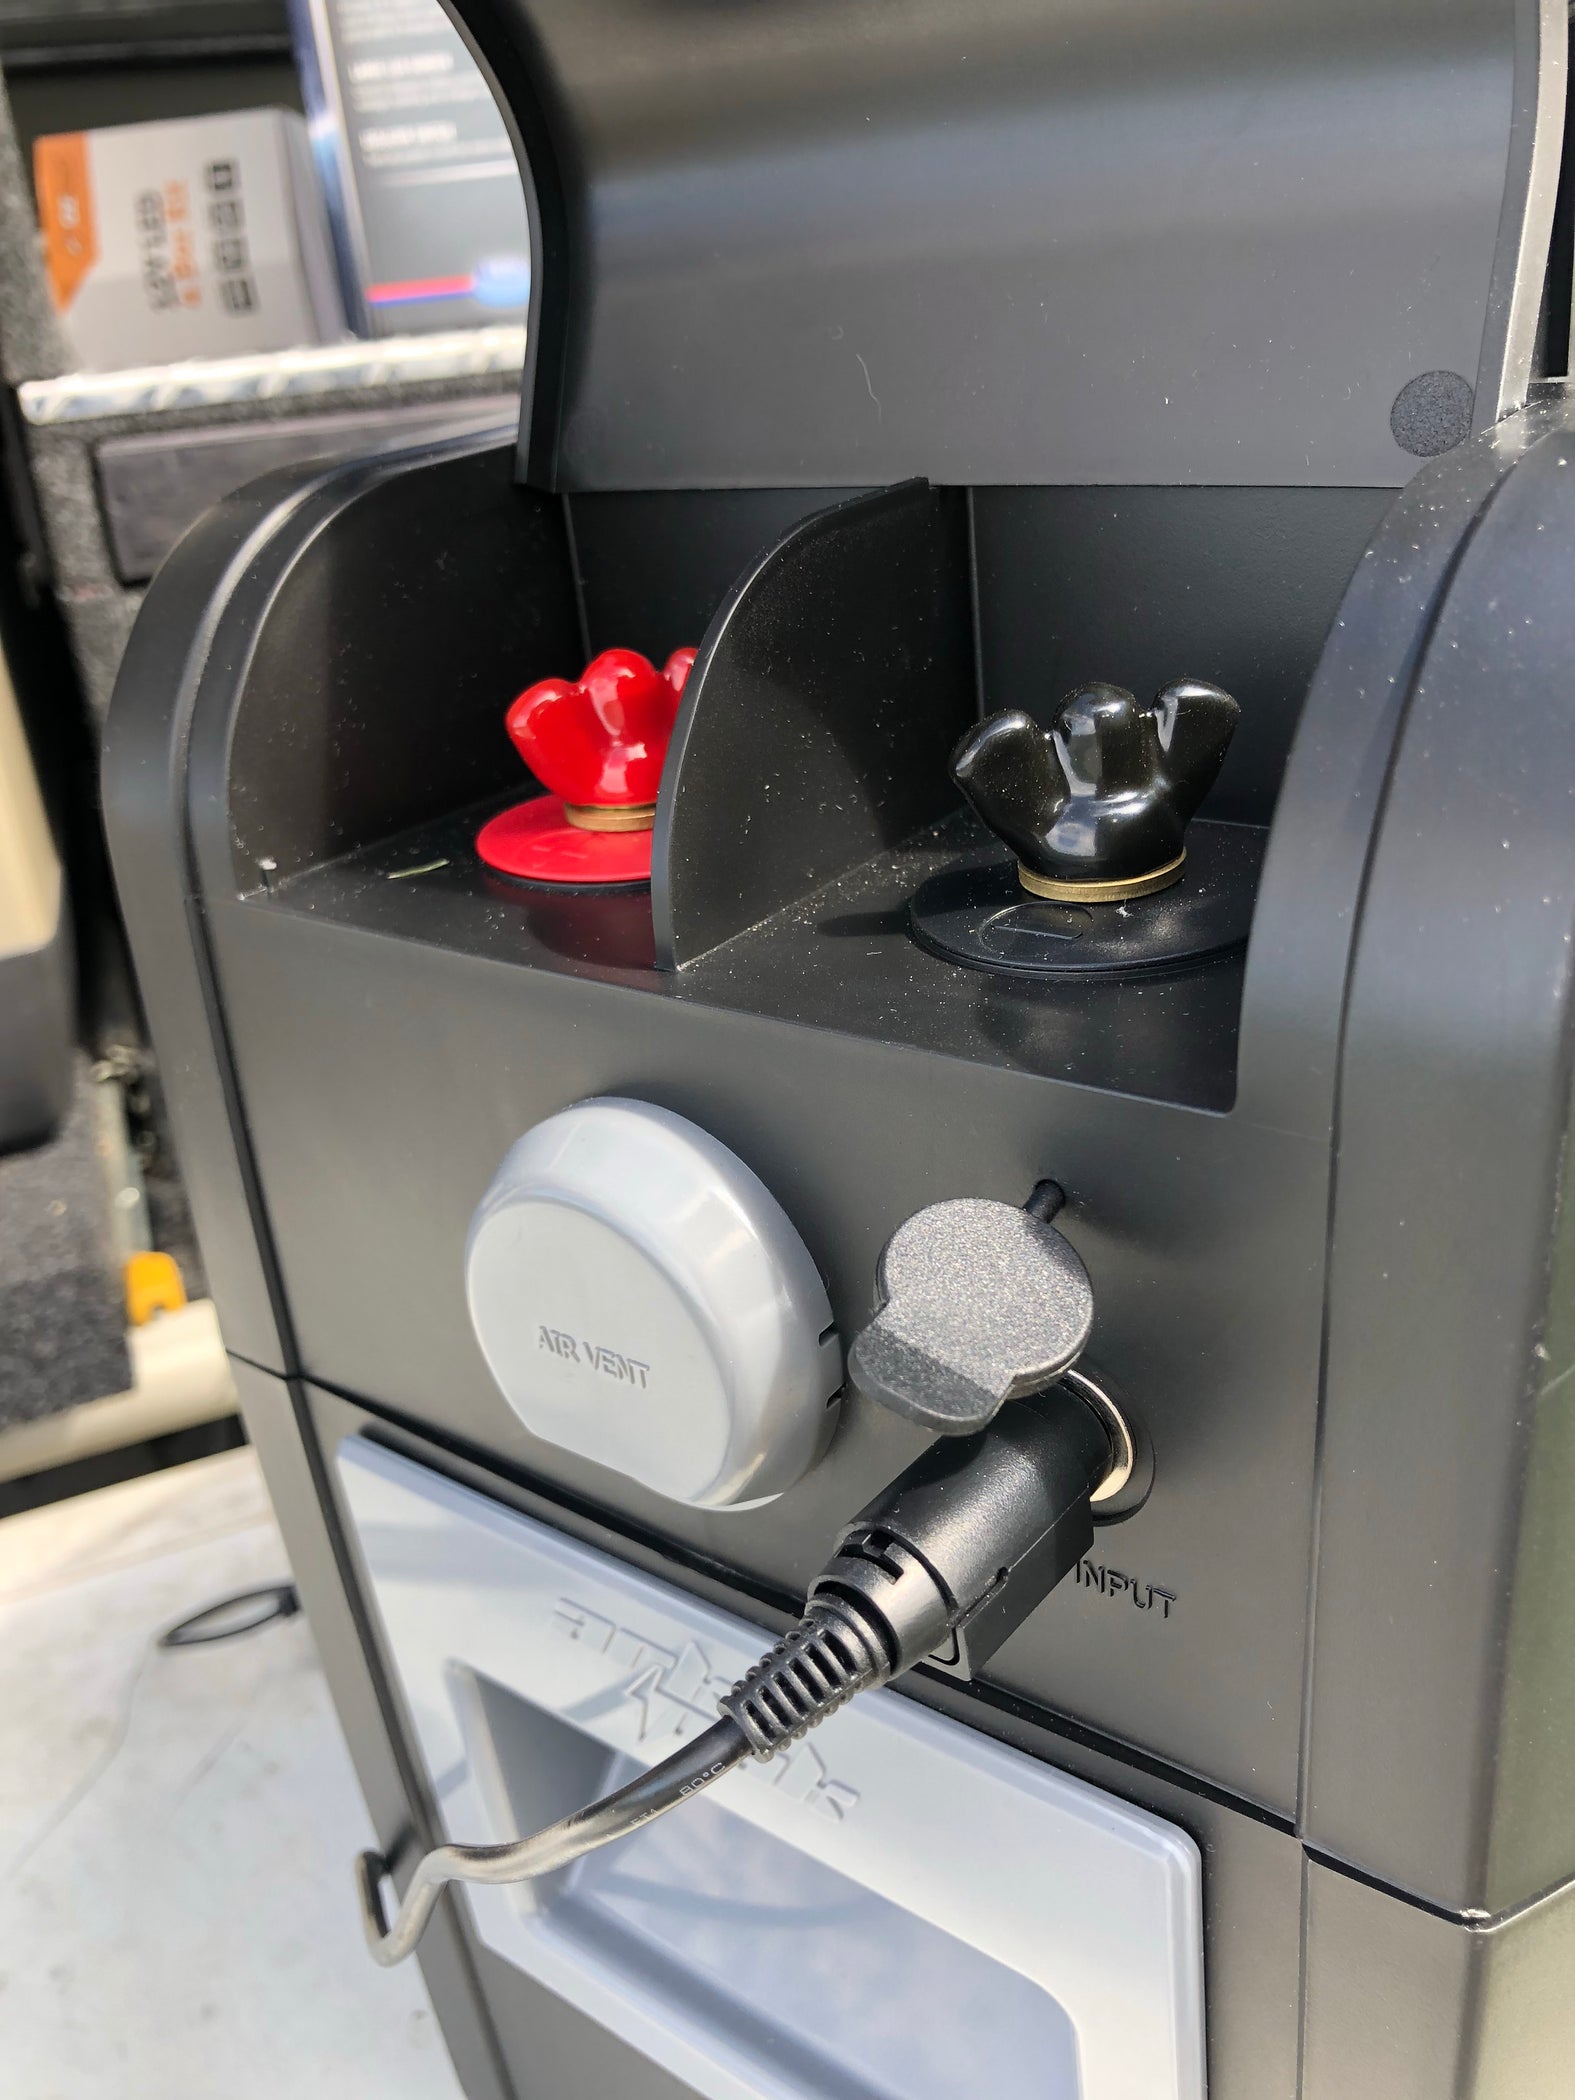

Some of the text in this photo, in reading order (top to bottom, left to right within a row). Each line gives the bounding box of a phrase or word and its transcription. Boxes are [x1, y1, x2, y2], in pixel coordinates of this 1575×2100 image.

[538, 1325, 651, 1390] AIR VENT
[1075, 1559, 1177, 1618] INPUT
